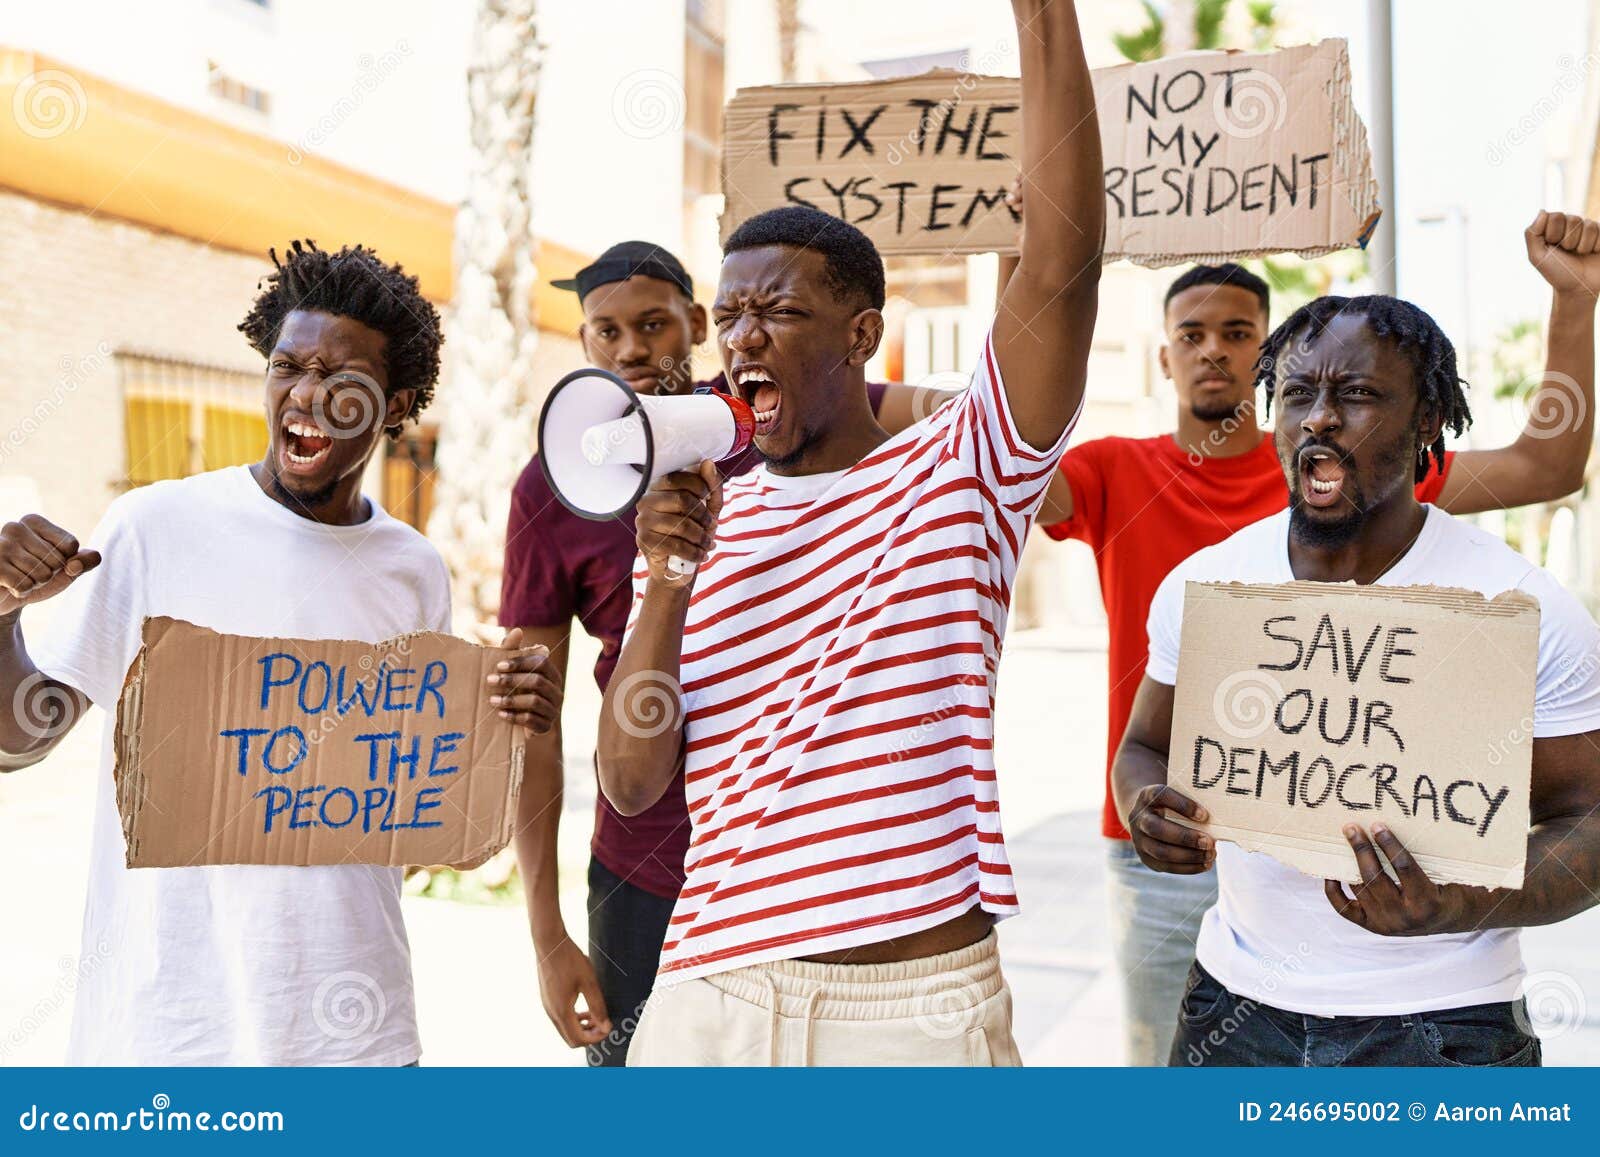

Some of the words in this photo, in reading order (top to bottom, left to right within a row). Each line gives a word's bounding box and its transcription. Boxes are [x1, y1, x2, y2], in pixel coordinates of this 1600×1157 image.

[1127, 69, 1252, 122] NOT
[768, 97, 888, 166] FIX
[907, 99, 1020, 160] THE
[1147, 123, 1219, 168] MY
[785, 176, 1022, 234] SYSTEM
[1104, 153, 1328, 218] RESIDENT
[1257, 614, 1418, 684] SAVE
[257, 652, 448, 718] POWER
[1274, 688, 1405, 752] OUR
[220, 725, 308, 776] TO
[354, 730, 465, 784] THE
[1192, 736, 1510, 837] DEMOCRACY
[253, 785, 444, 834] PEOPLE
